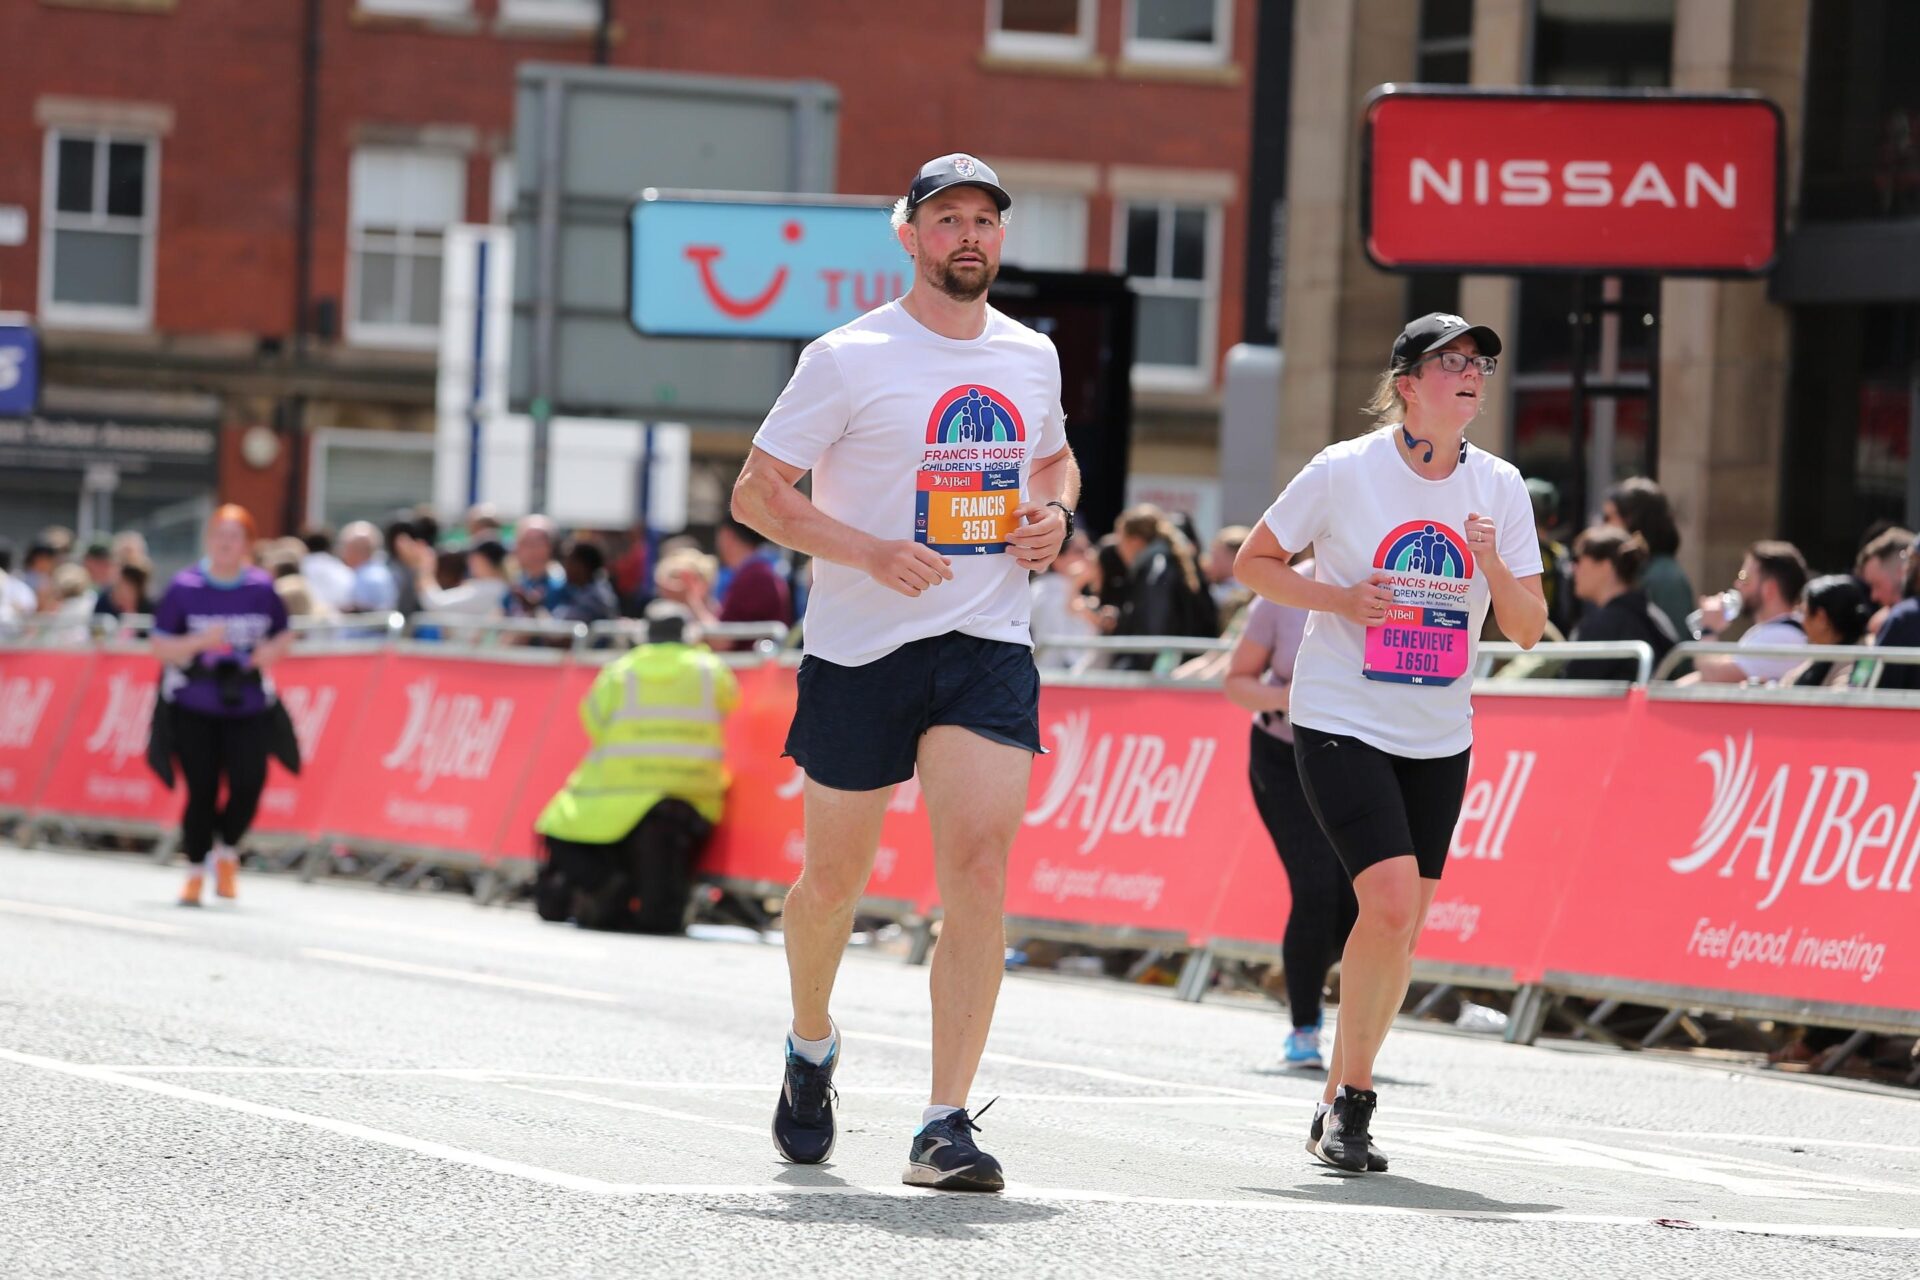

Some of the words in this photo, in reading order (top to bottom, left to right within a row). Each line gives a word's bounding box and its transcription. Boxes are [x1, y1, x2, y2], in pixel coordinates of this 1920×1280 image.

[1409, 158, 1737, 209] NISSAN
[818, 269, 904, 311] TUI
[924, 449, 978, 461] FRANCIS
[982, 447, 1025, 460] HOUSE
[922, 462, 982, 472] CHILDREN'S
[951, 495, 1005, 518] FRANCIS
[962, 519, 997, 541] 3591
[975, 546, 986, 554] 10K
[1386, 576, 1426, 589] ANCIS
[1428, 580, 1470, 594] HOUSE
[1427, 591, 1466, 604] HOSPIC
[1383, 628, 1454, 653] GENEVIEVE
[1395, 651, 1439, 673] 16501
[1412, 676, 1423, 684] 10K
[1055, 732, 1217, 856] AJBell
[1686, 915, 1737, 959] Feel
[1727, 926, 1793, 970] good,
[1791, 928, 1887, 983] investing.
